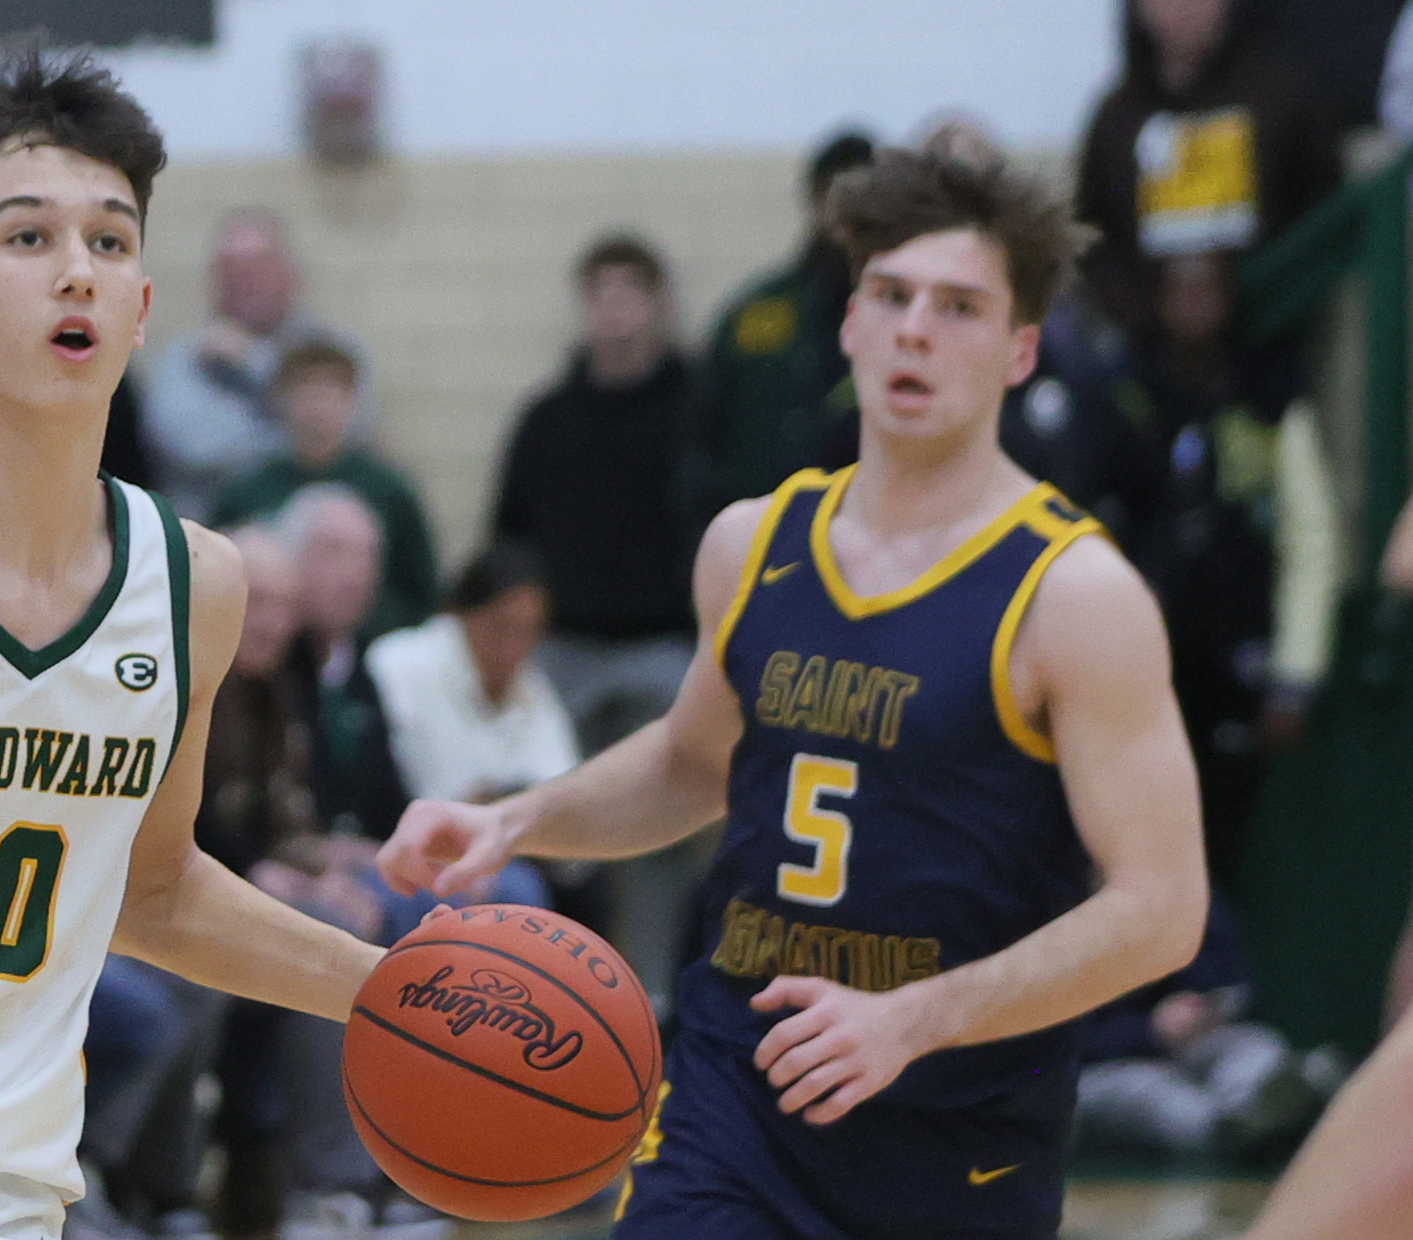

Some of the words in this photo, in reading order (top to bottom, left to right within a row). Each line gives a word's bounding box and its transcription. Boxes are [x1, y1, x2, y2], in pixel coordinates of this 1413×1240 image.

[117, 655, 158, 691] E
[756, 650, 921, 749] SAINT
[776, 752, 859, 908] 5
[399, 965, 584, 1071] Rawlings
